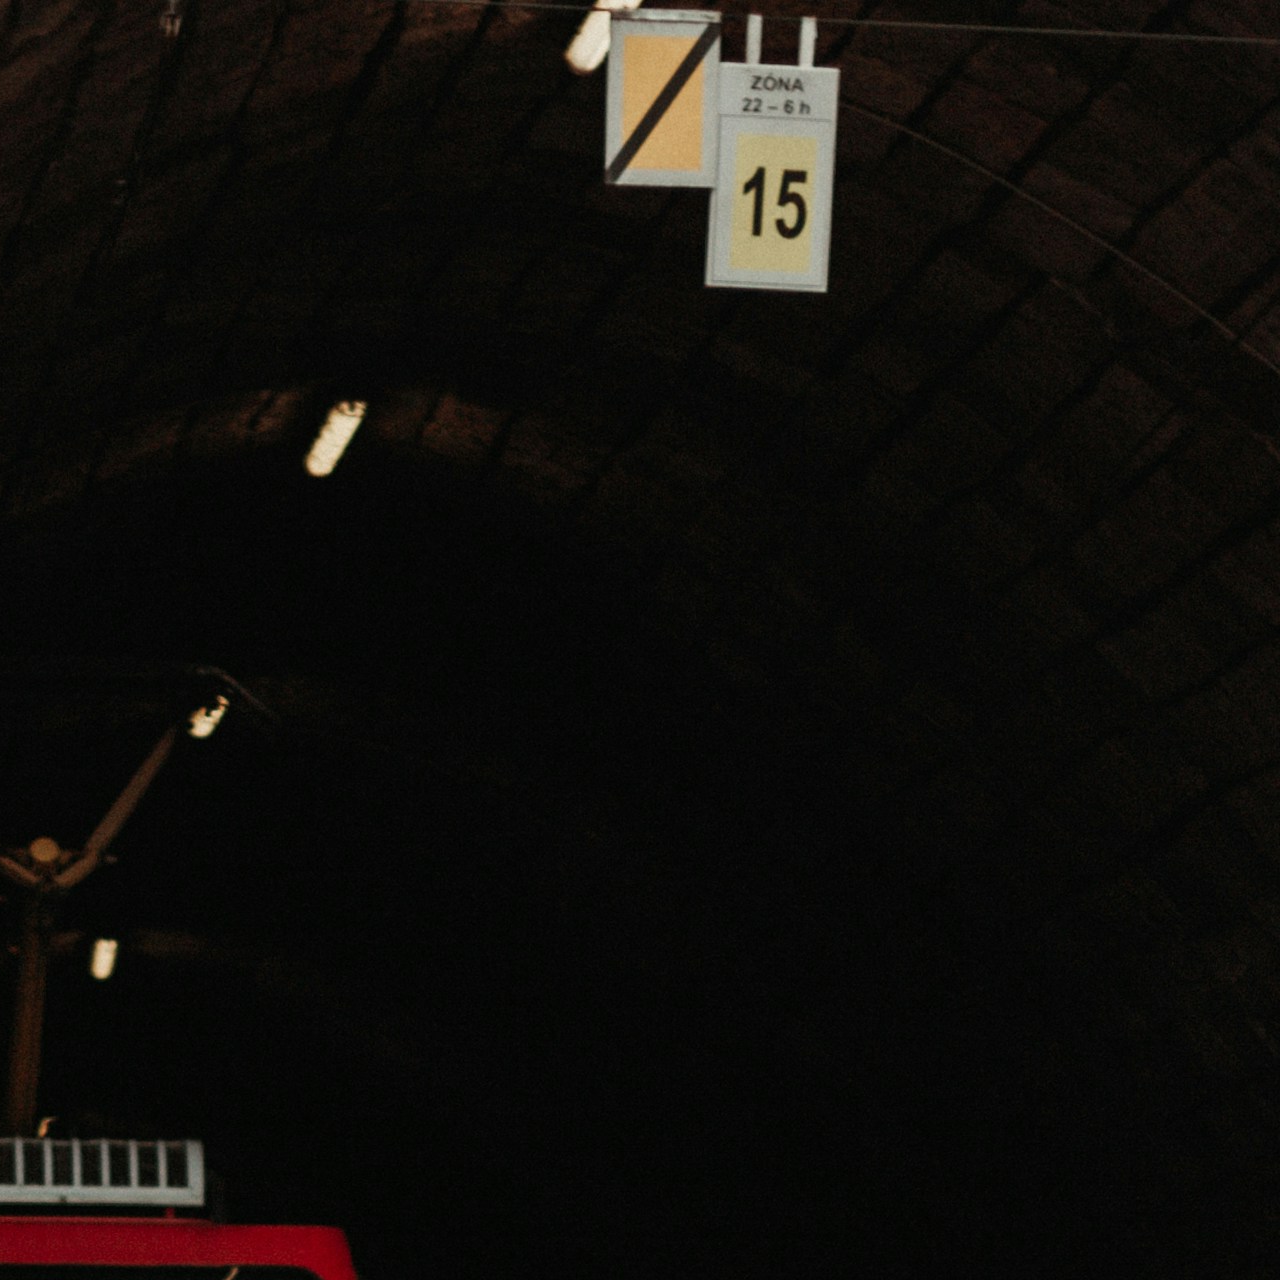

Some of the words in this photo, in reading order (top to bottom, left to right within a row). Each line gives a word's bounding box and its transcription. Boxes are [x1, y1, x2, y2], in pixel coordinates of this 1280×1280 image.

[742, 98, 762, 113] 22
[784, 99, 794, 114] 6
[799, 101, 811, 115] h
[742, 166, 807, 239] 15
